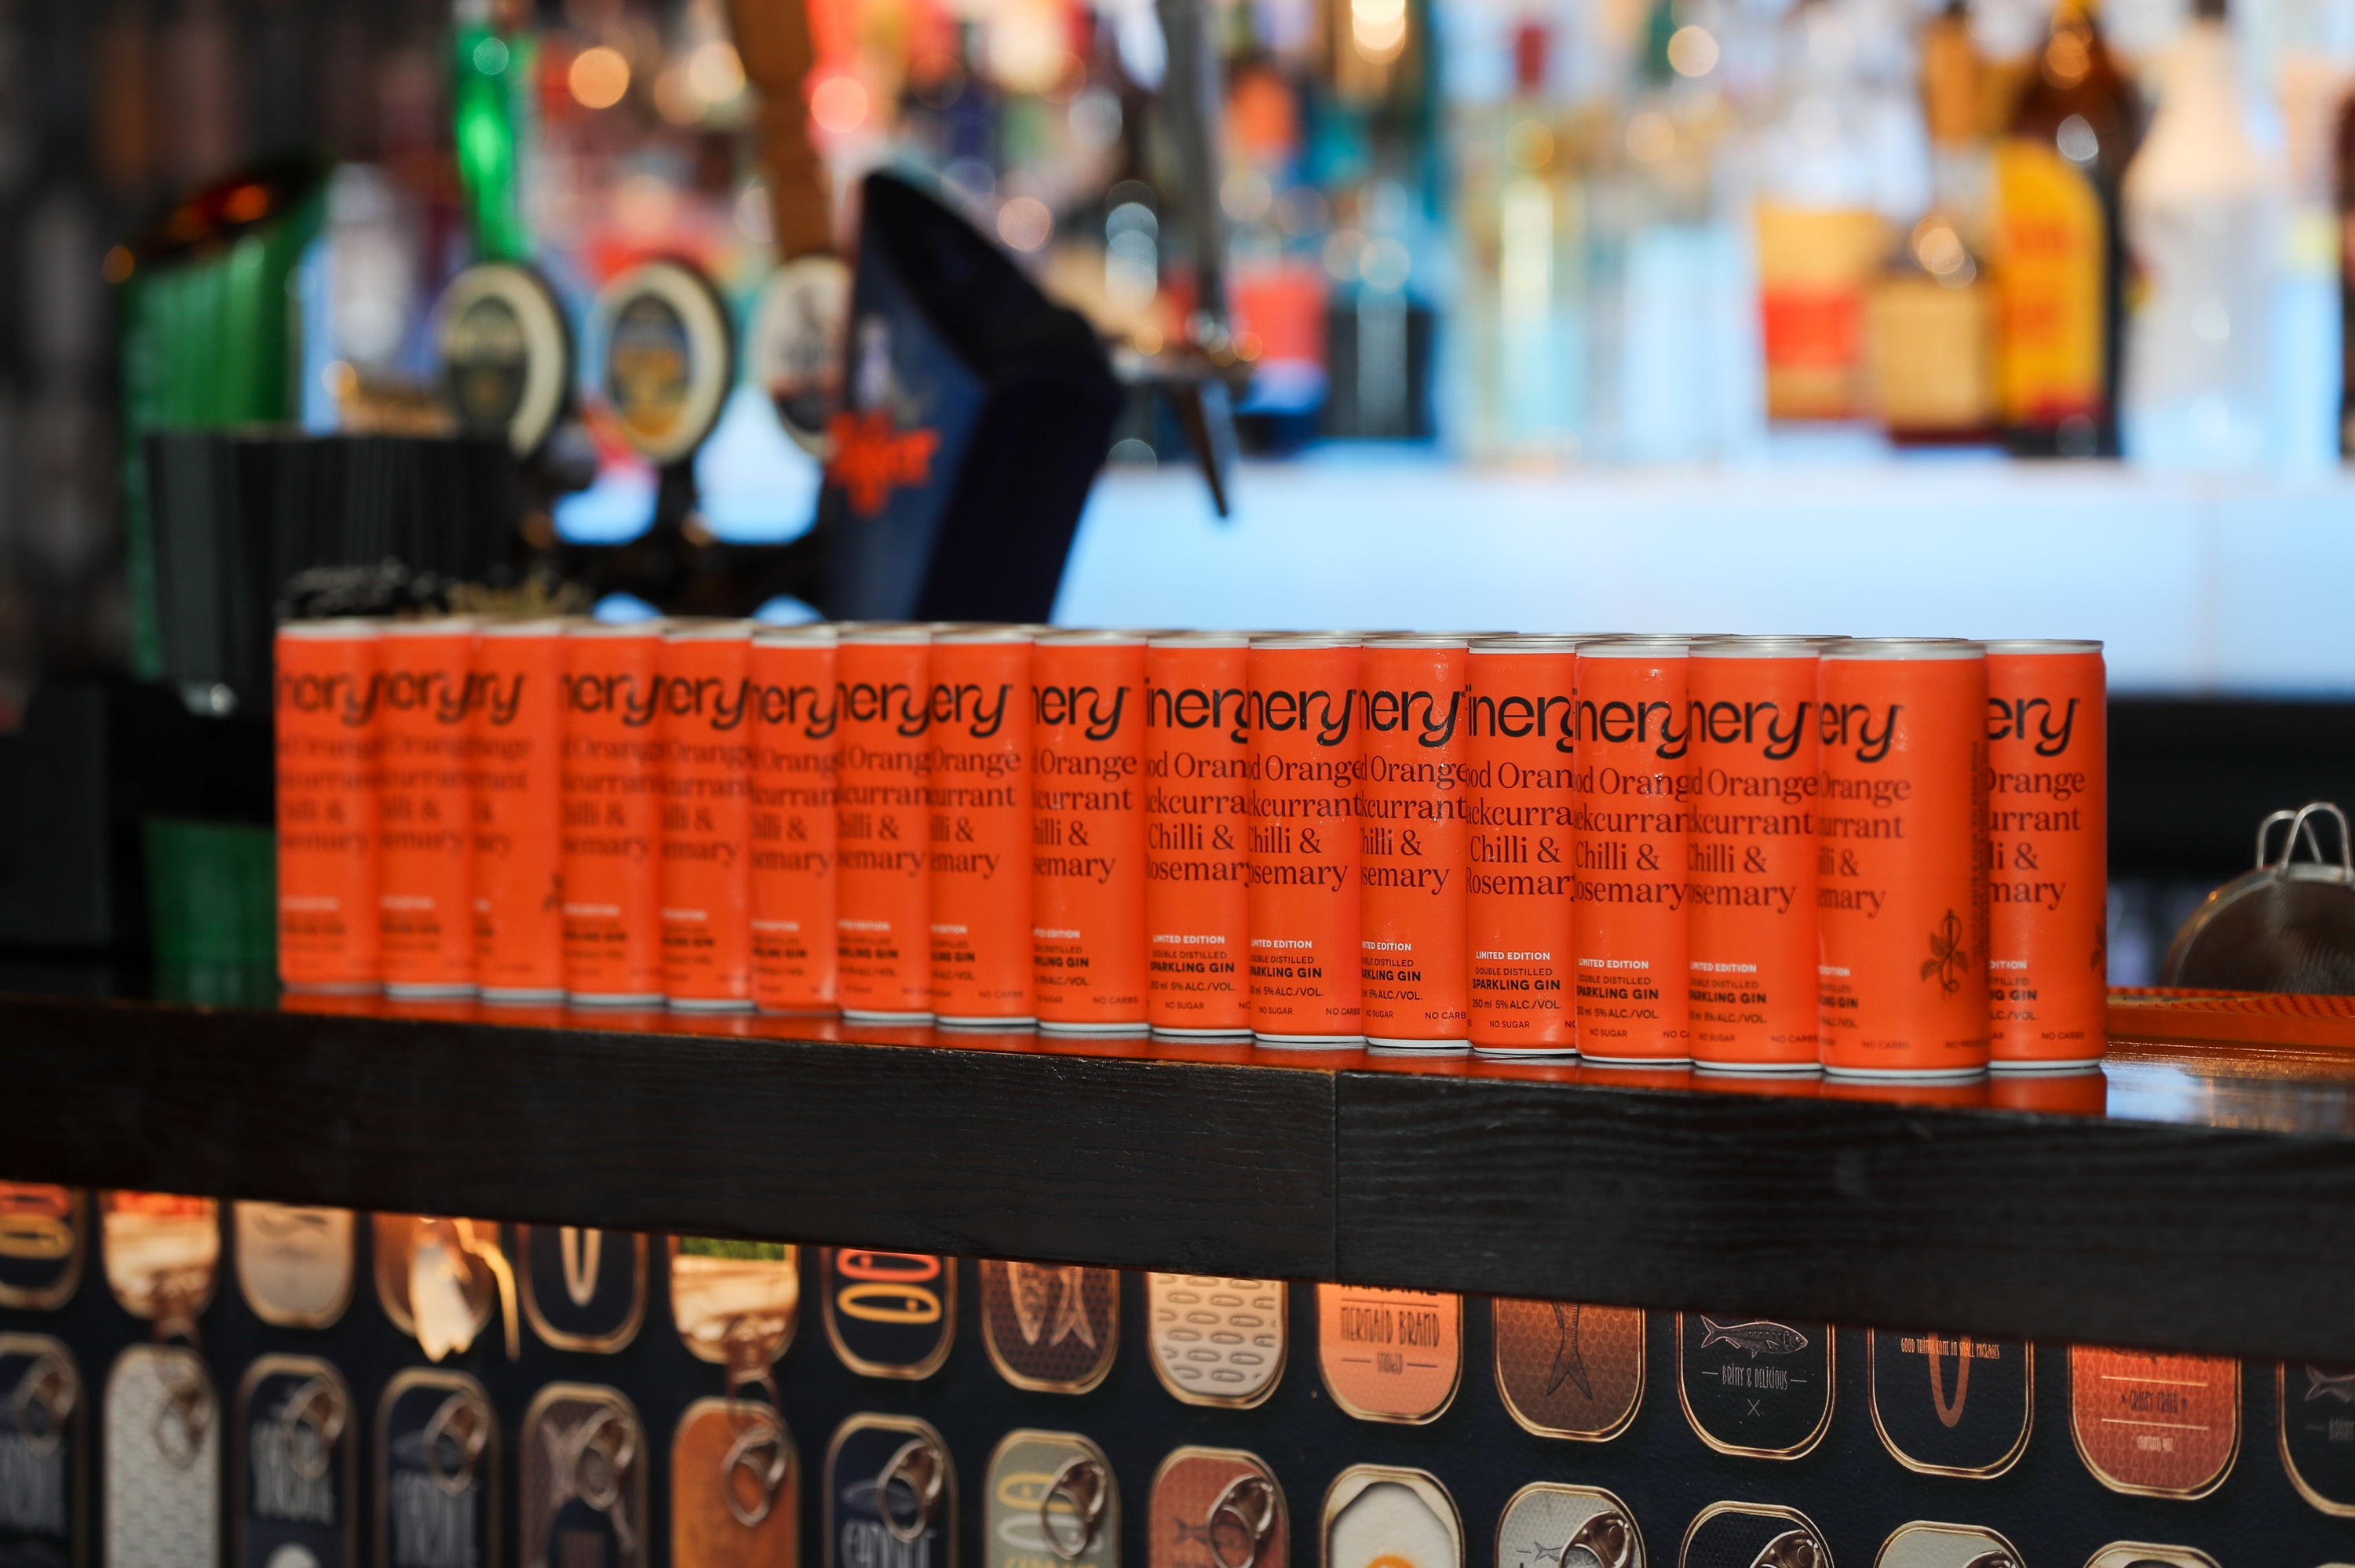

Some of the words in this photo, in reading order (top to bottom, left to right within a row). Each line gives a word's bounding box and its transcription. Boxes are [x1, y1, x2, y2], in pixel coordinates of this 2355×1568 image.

[1040, 748, 1137, 782] Orange
[1708, 768, 1818, 804] Orange
[1068, 820, 1089, 847] &
[1148, 822, 1203, 850] Chilli
[1212, 825, 1235, 850] &
[1300, 827, 1322, 854] &
[1400, 830, 1422, 856] &
[1470, 834, 1528, 863] Chilli
[1537, 837, 1561, 863] &
[1575, 841, 1627, 870] Chilli
[1637, 844, 1659, 870] &
[1744, 846, 1767, 873] &
[2014, 842, 2038, 870] &
[1840, 848, 1859, 877] &
[1183, 935, 1225, 944] EDITION
[1273, 940, 1313, 949] EDITION
[1377, 942, 1411, 951] EDITION
[1180, 951, 1227, 960] DISTILLED
[1476, 951, 1505, 960] LIMITED
[1507, 952, 1550, 961] EDITION
[1067, 957, 1090, 968] GIN
[1210, 963, 1234, 973] GIN
[1375, 958, 1414, 967] DISTILLED
[1579, 958, 1605, 968] LIMITED
[1607, 960, 1648, 969] EDITION
[1715, 963, 1757, 973] EDITION
[1297, 968, 1322, 978] GIN
[1397, 972, 1421, 981] GIN
[1503, 968, 1553, 976] DISTILLED
[1473, 979, 1530, 990] SPARKLING
[1535, 979, 1561, 990] GIN
[1603, 976, 1651, 985] DISTILLED
[1576, 986, 1628, 999] SPARKLING
[1633, 989, 1659, 1000] GIN
[1740, 993, 1766, 1004] GIN
[2010, 990, 2038, 1001] GIN
[1473, 999, 1483, 1008] 250
[1484, 999, 1492, 1008] ml
[1495, 1000, 1508, 1009] 5%
[1373, 1010, 1393, 1019] SUGAR
[1502, 1020, 1530, 1029] SUGAR
[1590, 1028, 1598, 1037] NO
[1601, 1029, 1627, 1037] SUGAR
[2041, 1032, 2054, 1041] NO
[1400, 1310, 1440, 1348] BRAND
[1900, 1337, 1915, 1353] GOOD
[1722, 1364, 1744, 1387] BRINY
[1747, 1367, 1752, 1387] &
[1754, 1366, 1787, 1390] DELICIOUS
